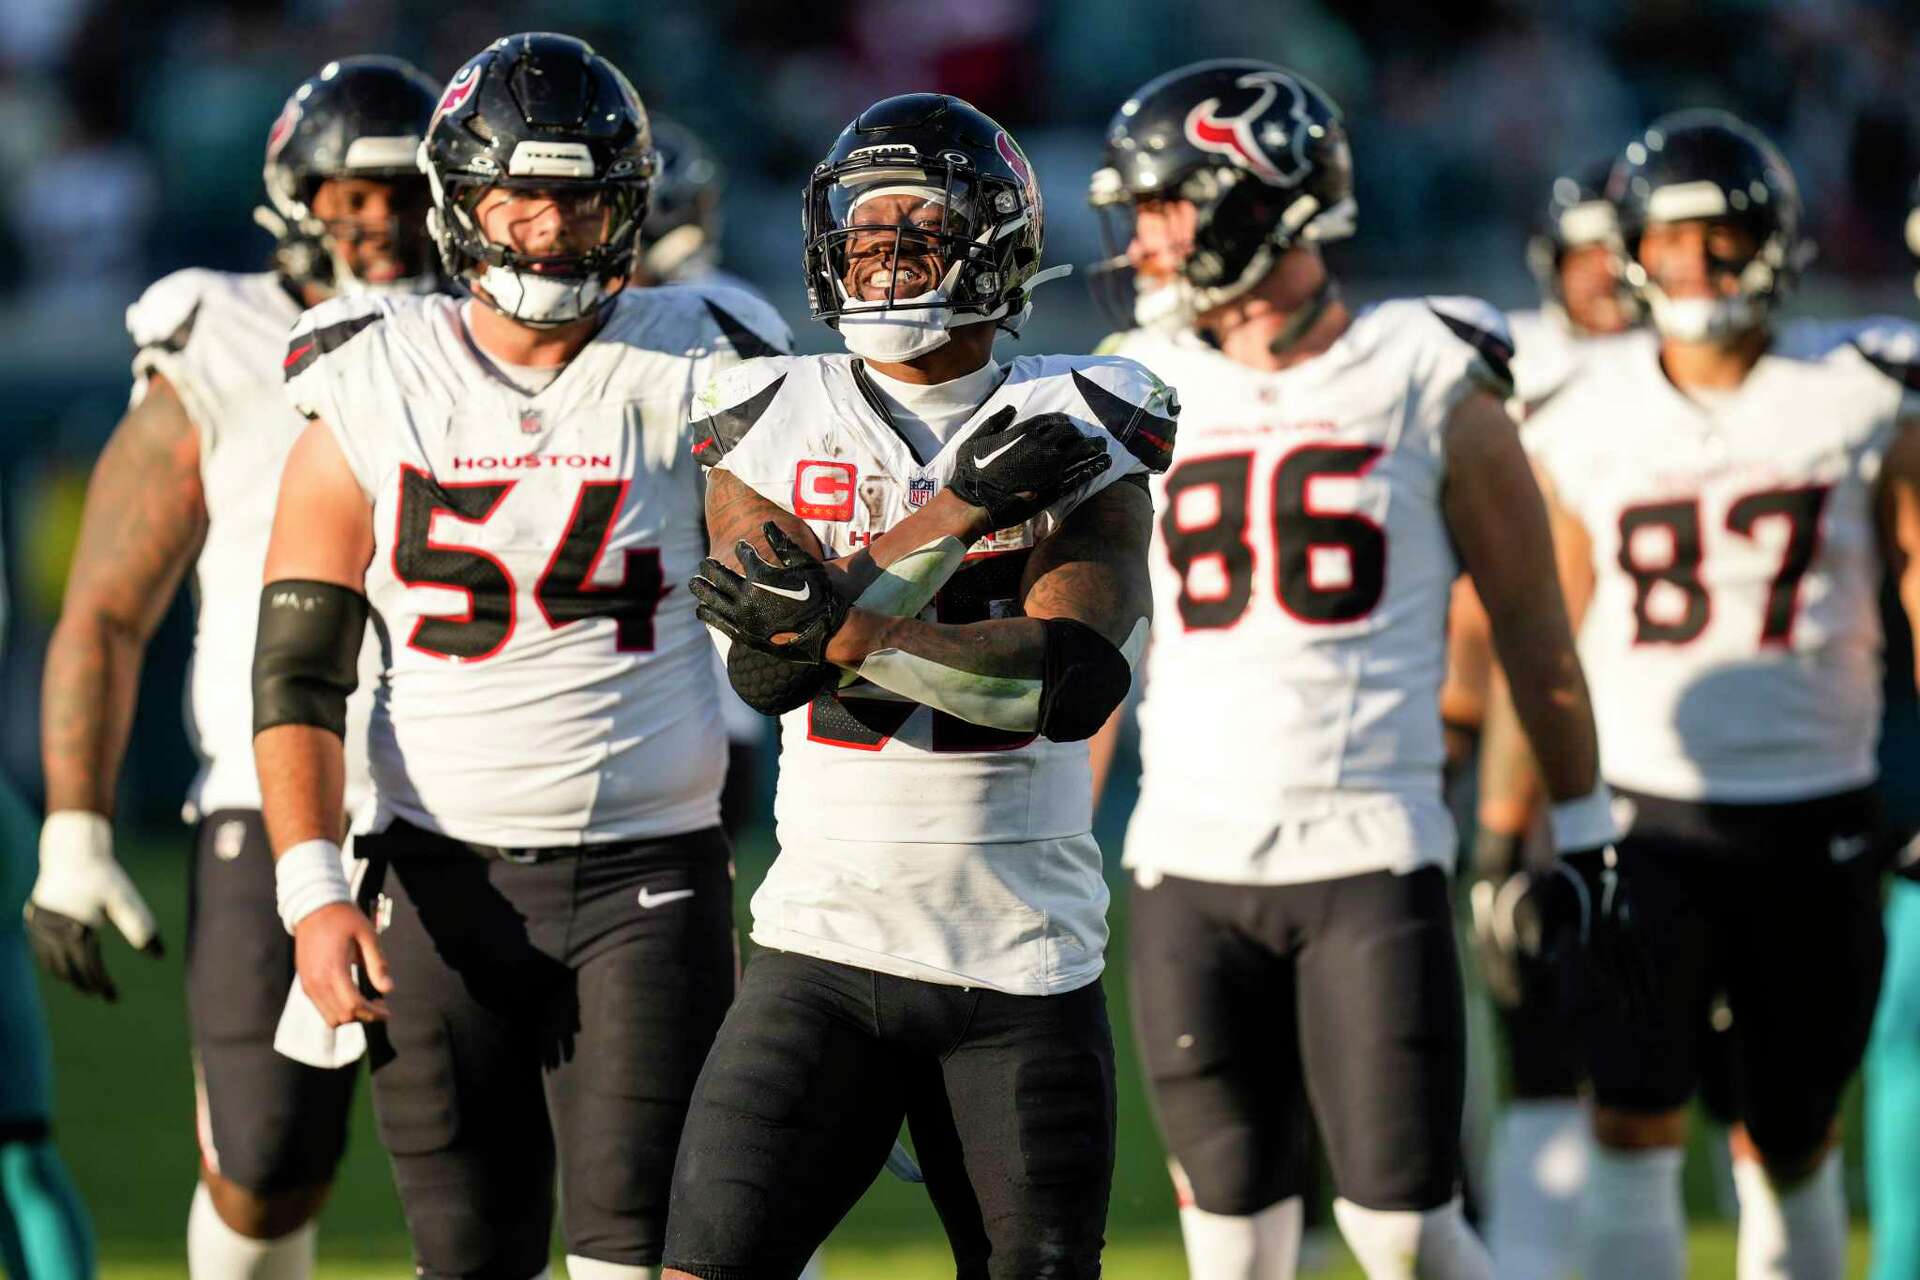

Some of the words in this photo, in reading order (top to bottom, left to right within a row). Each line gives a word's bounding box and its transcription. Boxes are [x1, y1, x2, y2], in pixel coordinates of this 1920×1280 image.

[453, 454, 612, 470] HOUSTON
[800, 464, 850, 505] C
[1161, 442, 1388, 634] 86
[391, 462, 675, 665] 54
[1617, 484, 1833, 650] 87
